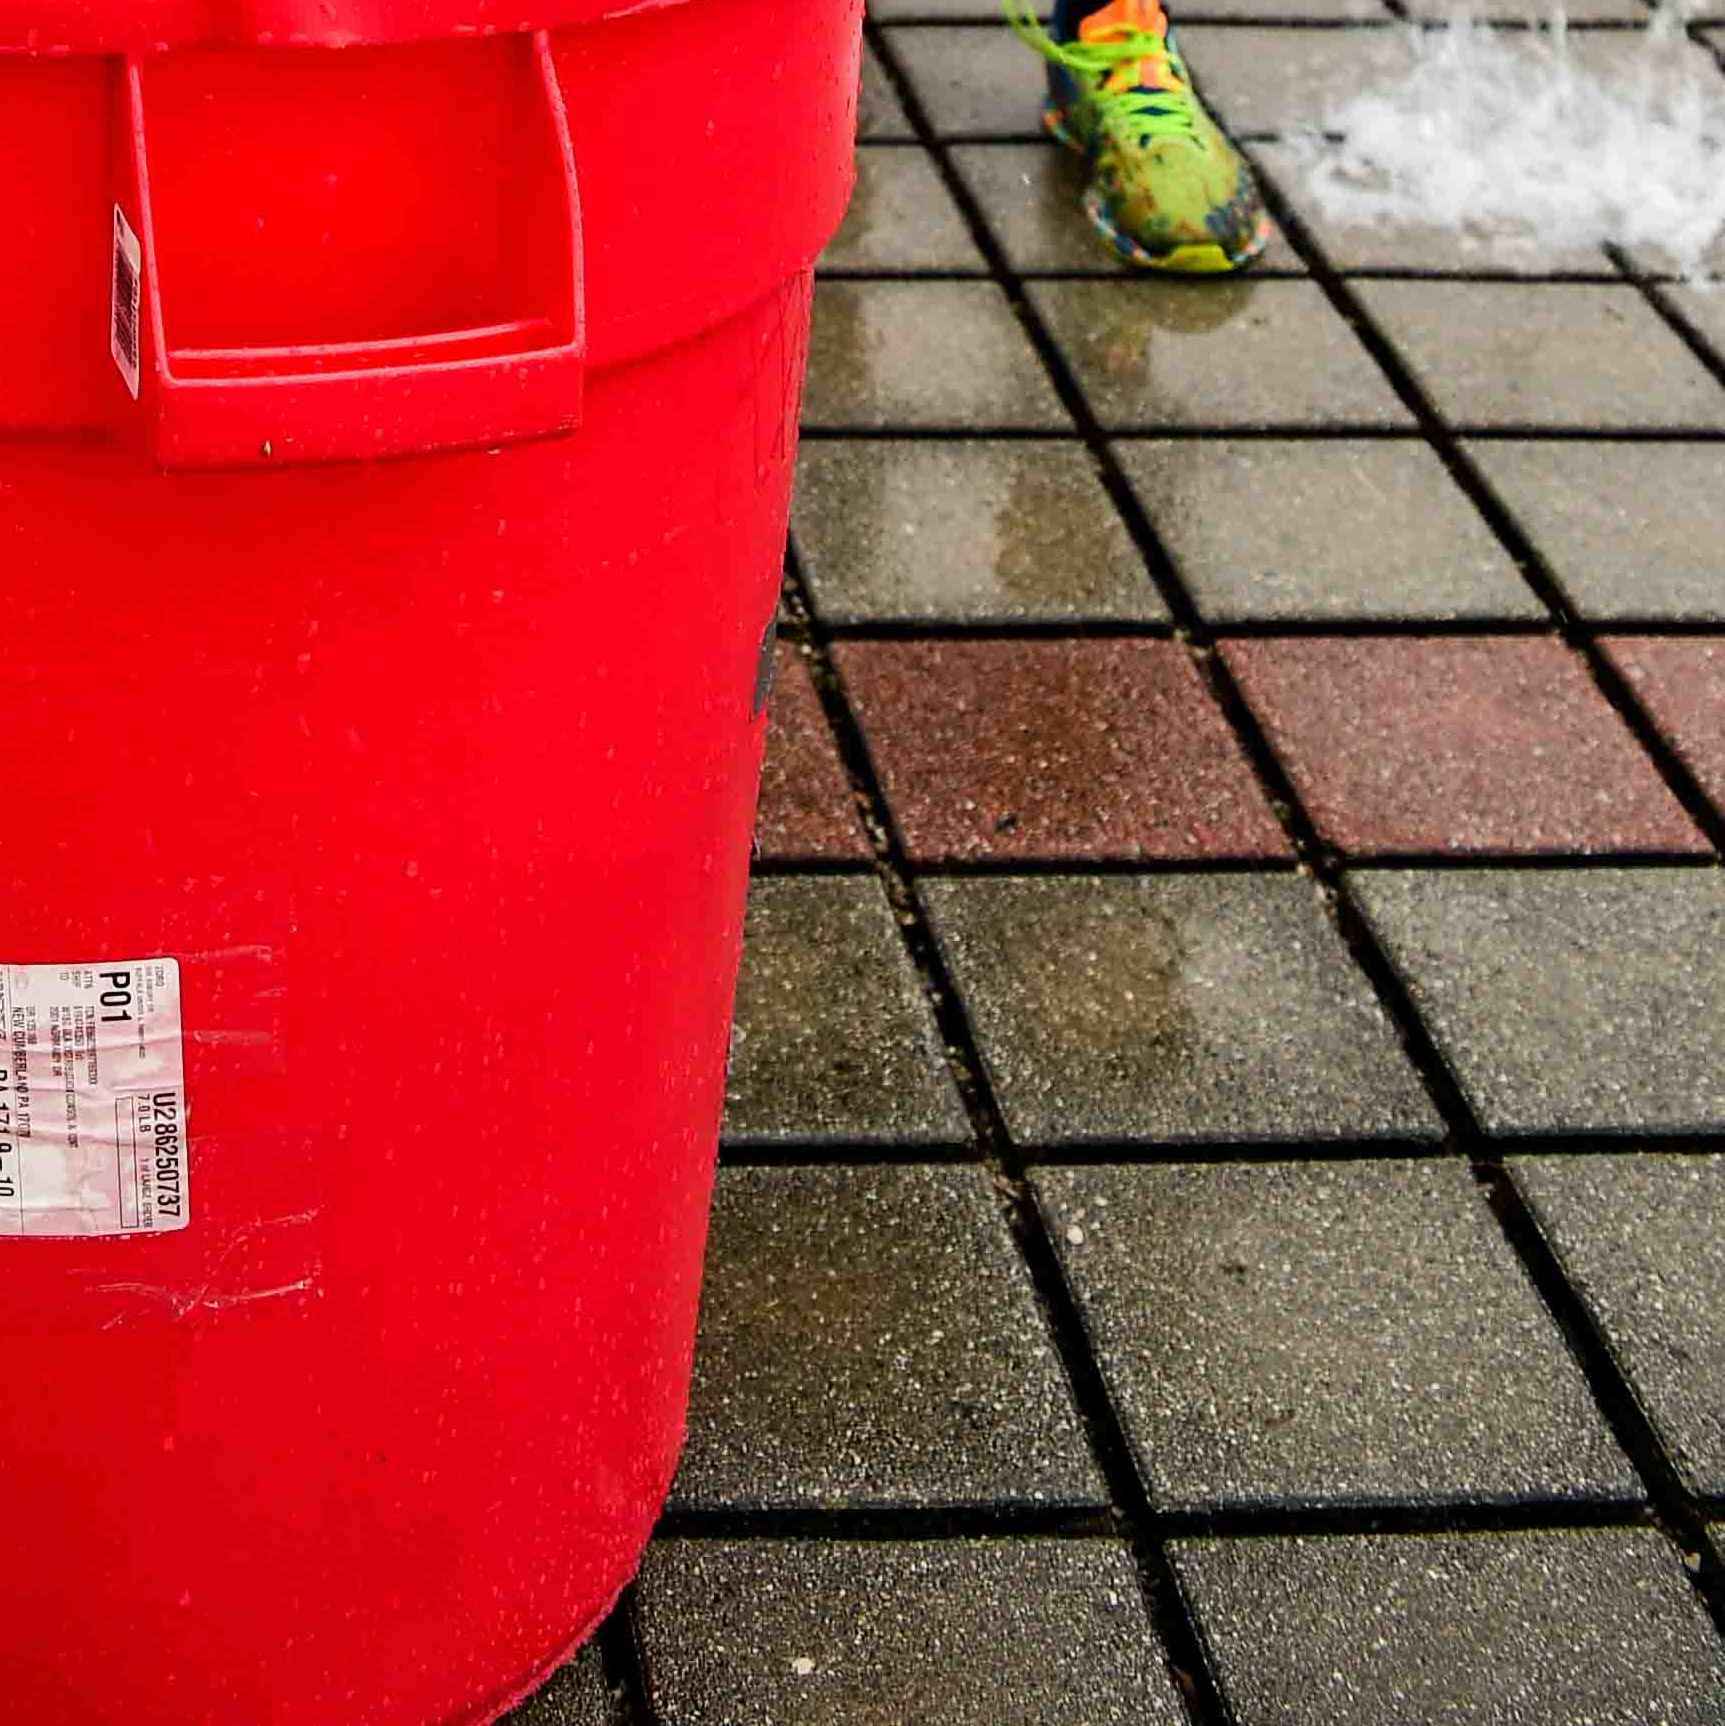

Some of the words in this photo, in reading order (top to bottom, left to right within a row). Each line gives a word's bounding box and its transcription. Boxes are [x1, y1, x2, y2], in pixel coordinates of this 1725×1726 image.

[100, 971, 132, 1022] P01
[13, 1007, 24, 1028] NEW
[18, 1096, 29, 1108] PA
[138, 1095, 150, 1112] 7.0
[139, 1117, 151, 1133] LB
[154, 1093, 180, 1217] U286250737
